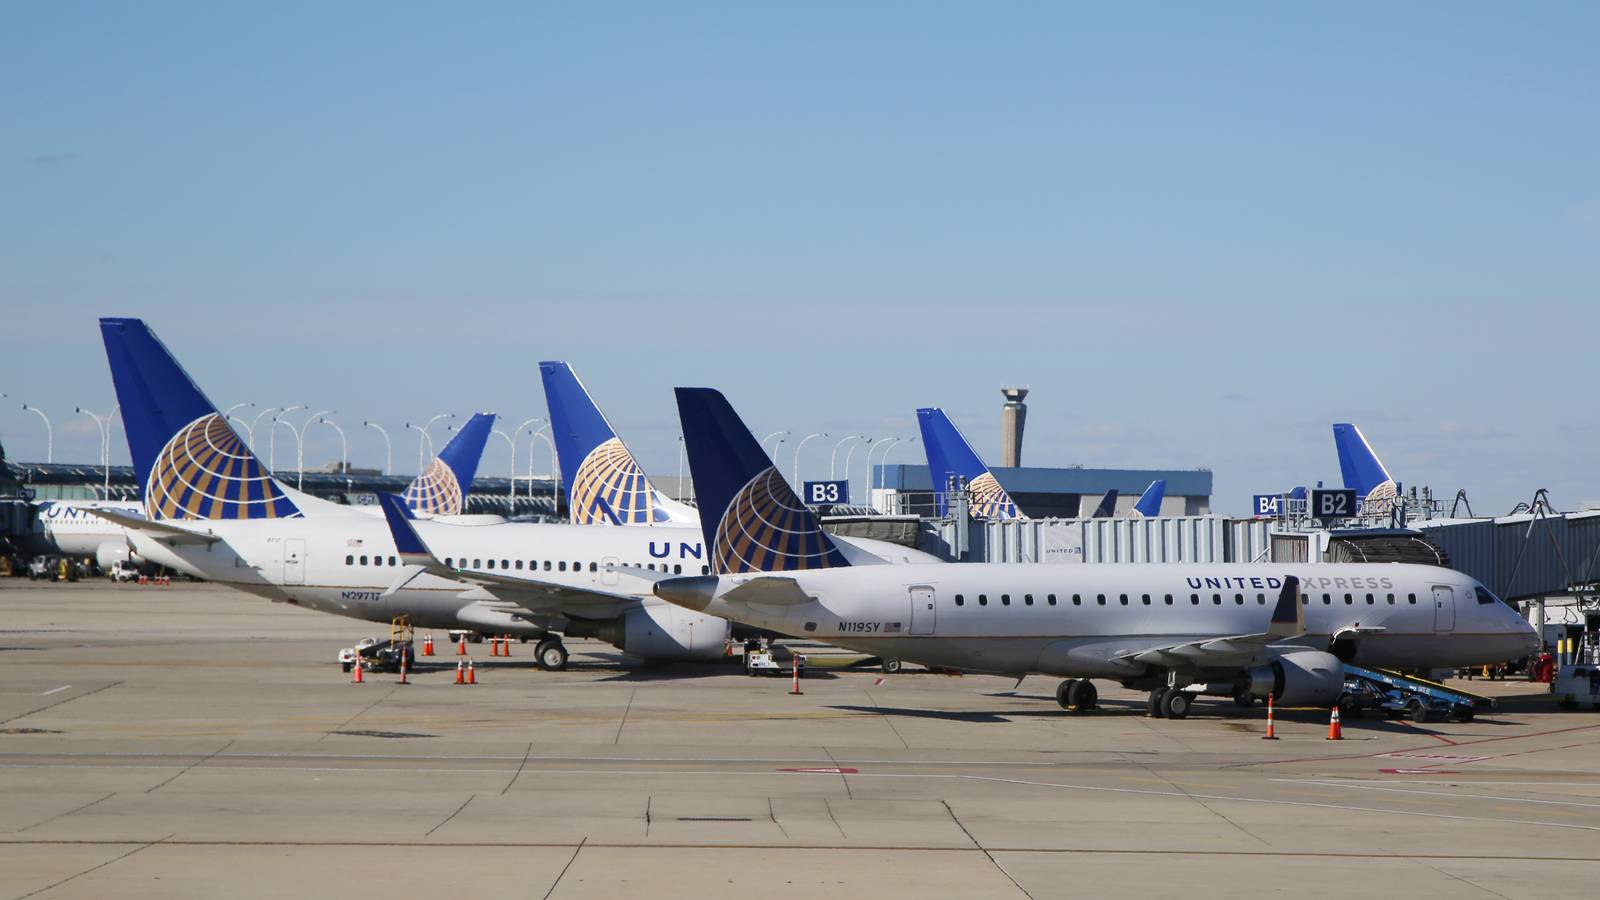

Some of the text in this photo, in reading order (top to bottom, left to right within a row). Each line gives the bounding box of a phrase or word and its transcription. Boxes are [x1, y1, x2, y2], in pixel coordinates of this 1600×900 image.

[812, 484, 839, 502] B3
[1259, 496, 1277, 513] B4
[1321, 493, 1347, 514] B2
[1186, 577, 1394, 590] UNITED XPRESS
[341, 591, 381, 601] N29717
[838, 621, 881, 633] N119SY
